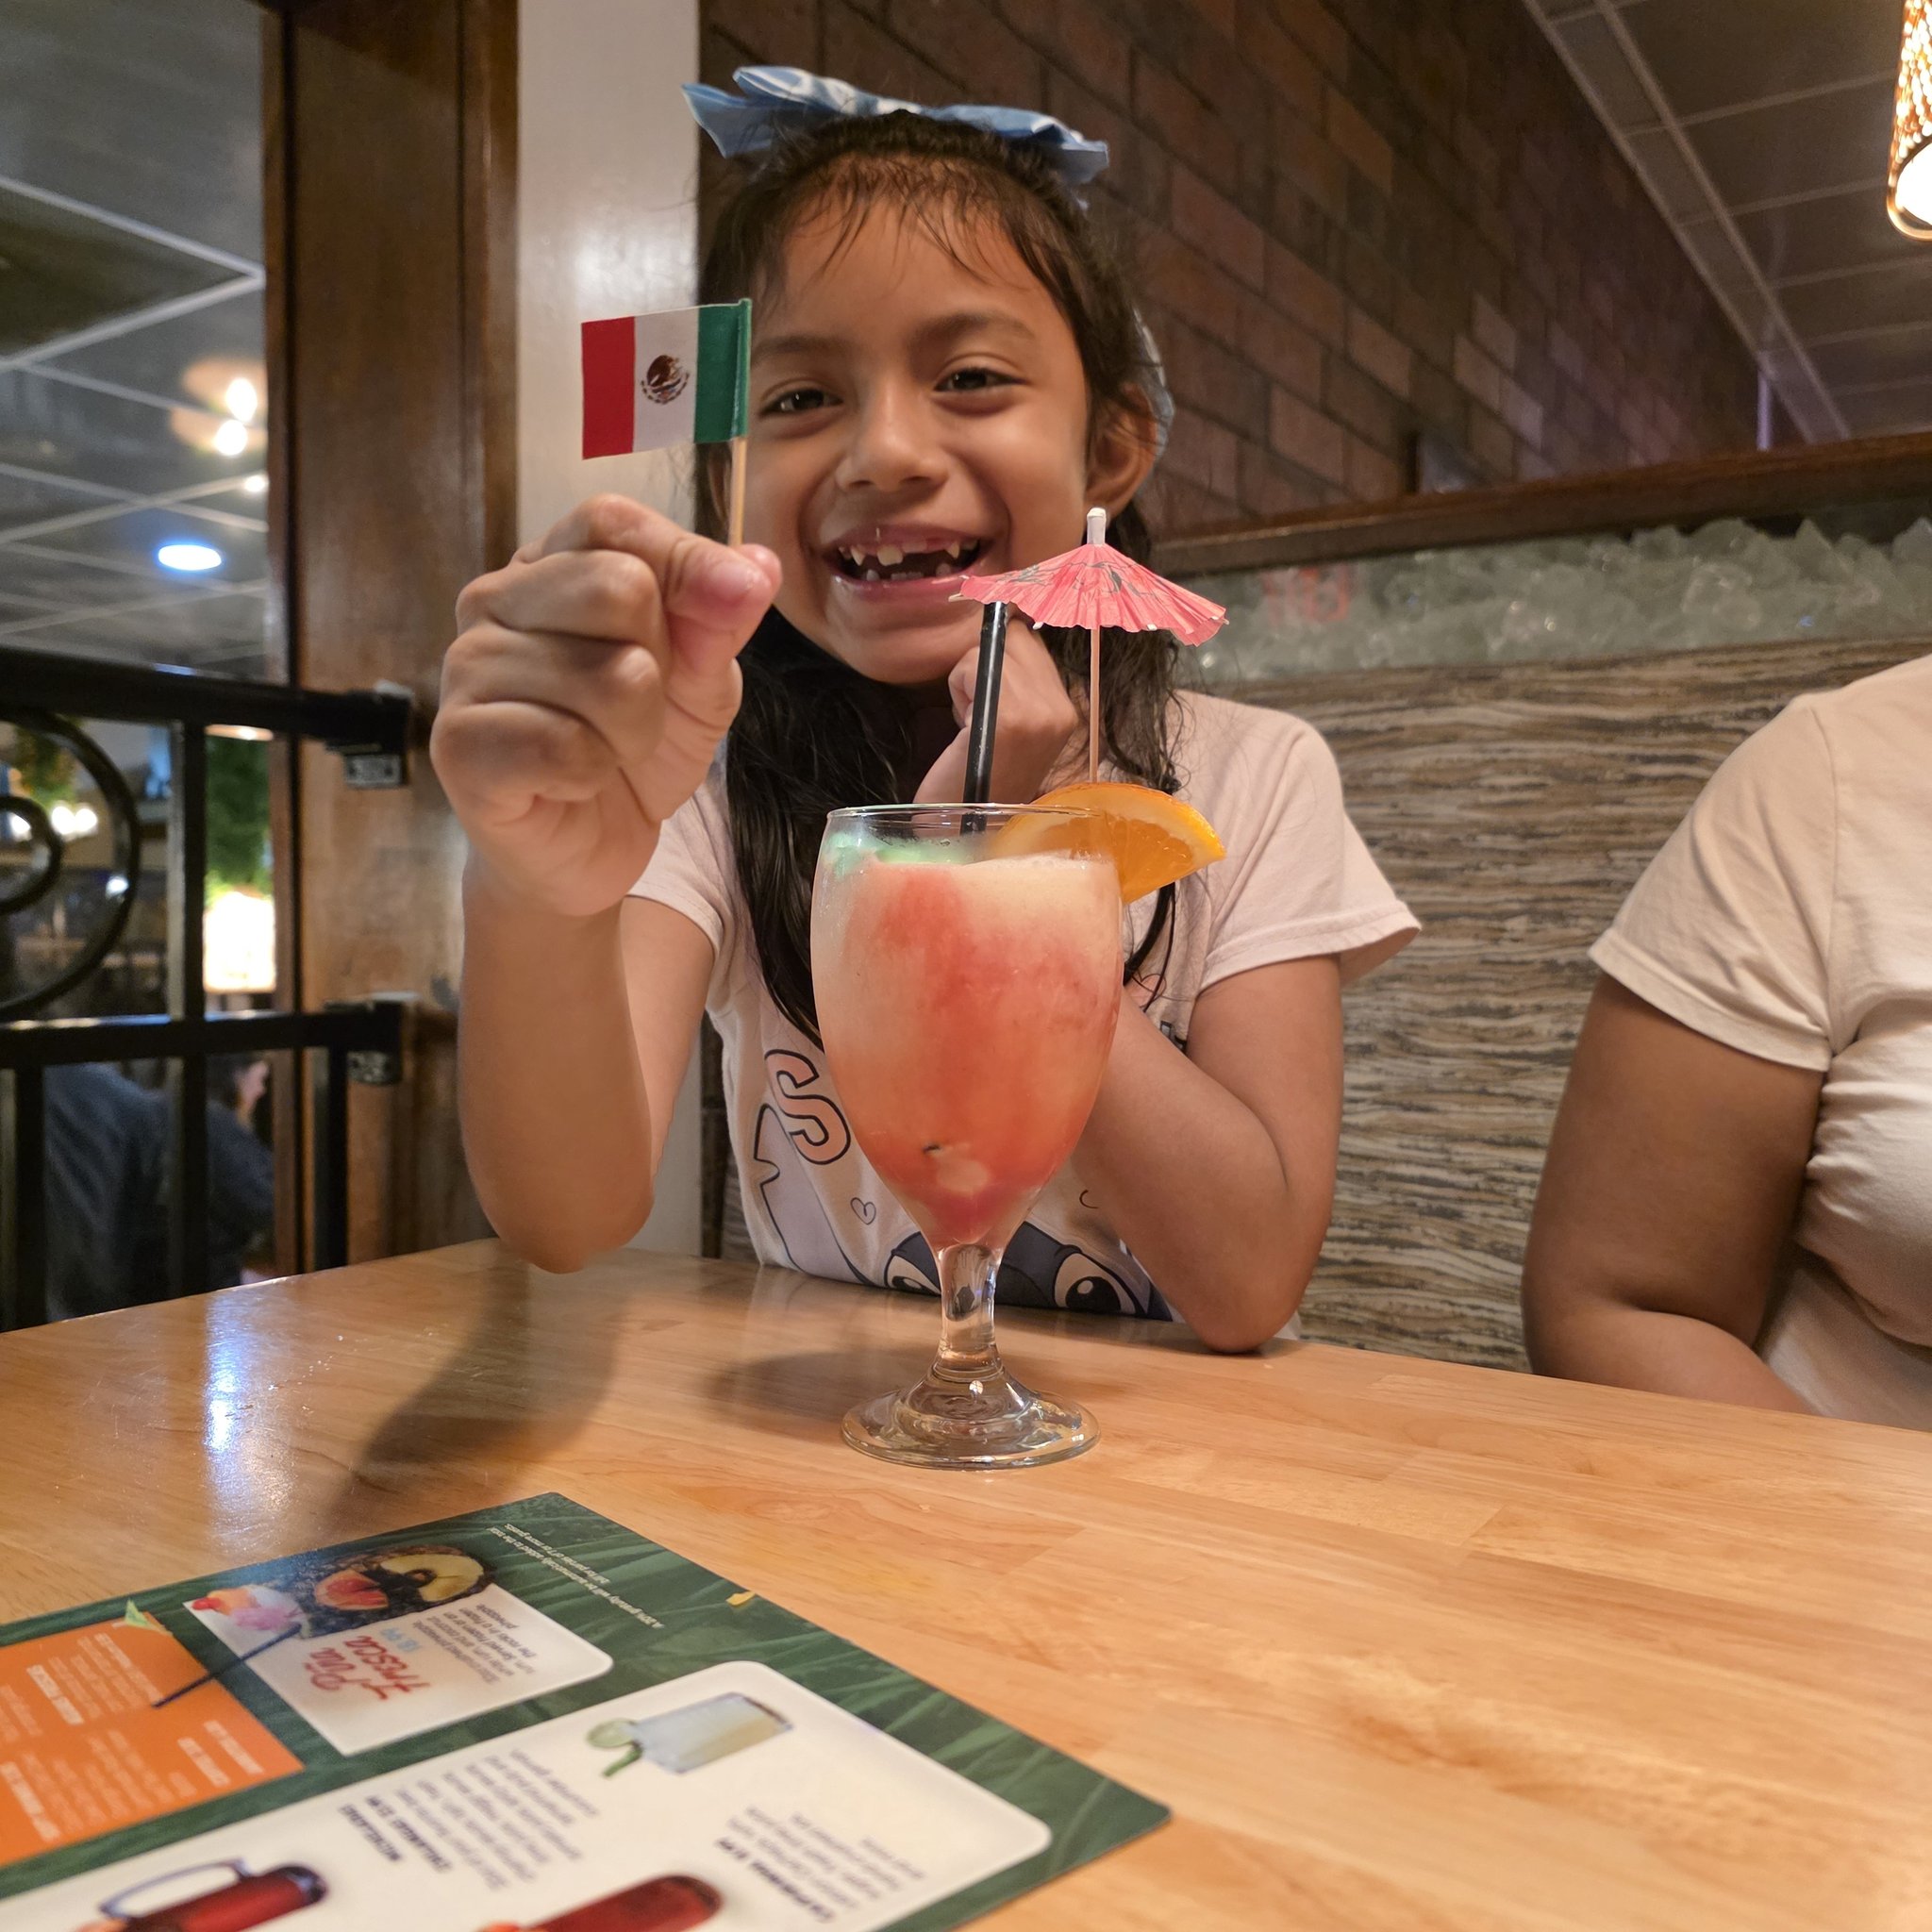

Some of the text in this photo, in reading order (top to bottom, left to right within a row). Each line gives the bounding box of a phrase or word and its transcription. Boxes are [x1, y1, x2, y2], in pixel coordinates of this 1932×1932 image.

[455, 1637, 475, 1648] and
[498, 1633, 521, 1649] rocks
[482, 1641, 517, 1660] Served
[521, 1647, 537, 1658] the
[342, 1636, 430, 1701] Fresca
